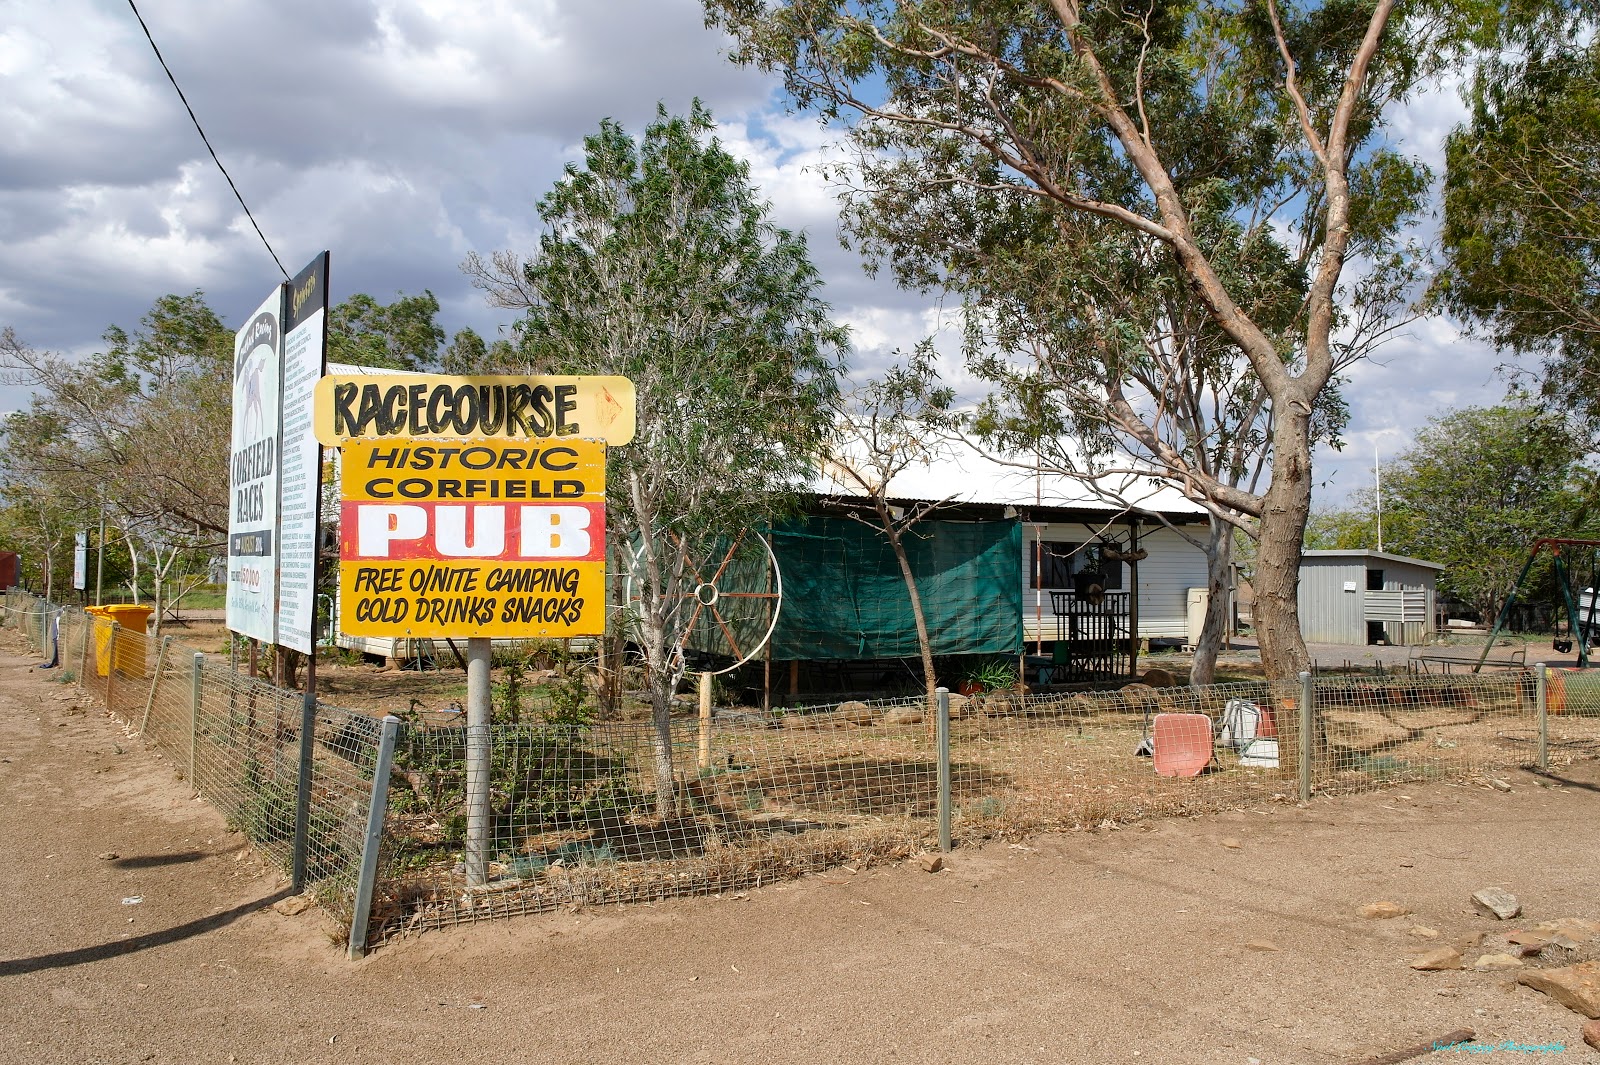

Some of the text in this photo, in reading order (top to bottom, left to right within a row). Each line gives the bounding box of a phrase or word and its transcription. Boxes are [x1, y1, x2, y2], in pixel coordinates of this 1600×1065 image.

[334, 383, 580, 438] RACECOURSE
[232, 436, 274, 488] CORFIELD
[367, 446, 579, 470] HISTORIC
[236, 481, 264, 523] RACES
[365, 478, 585, 498] CORFIELD
[358, 505, 591, 557] PUB
[354, 564, 580, 597] FREE O/NITE CAMPING
[356, 596, 584, 626] COLD DRINKS SNACKS
